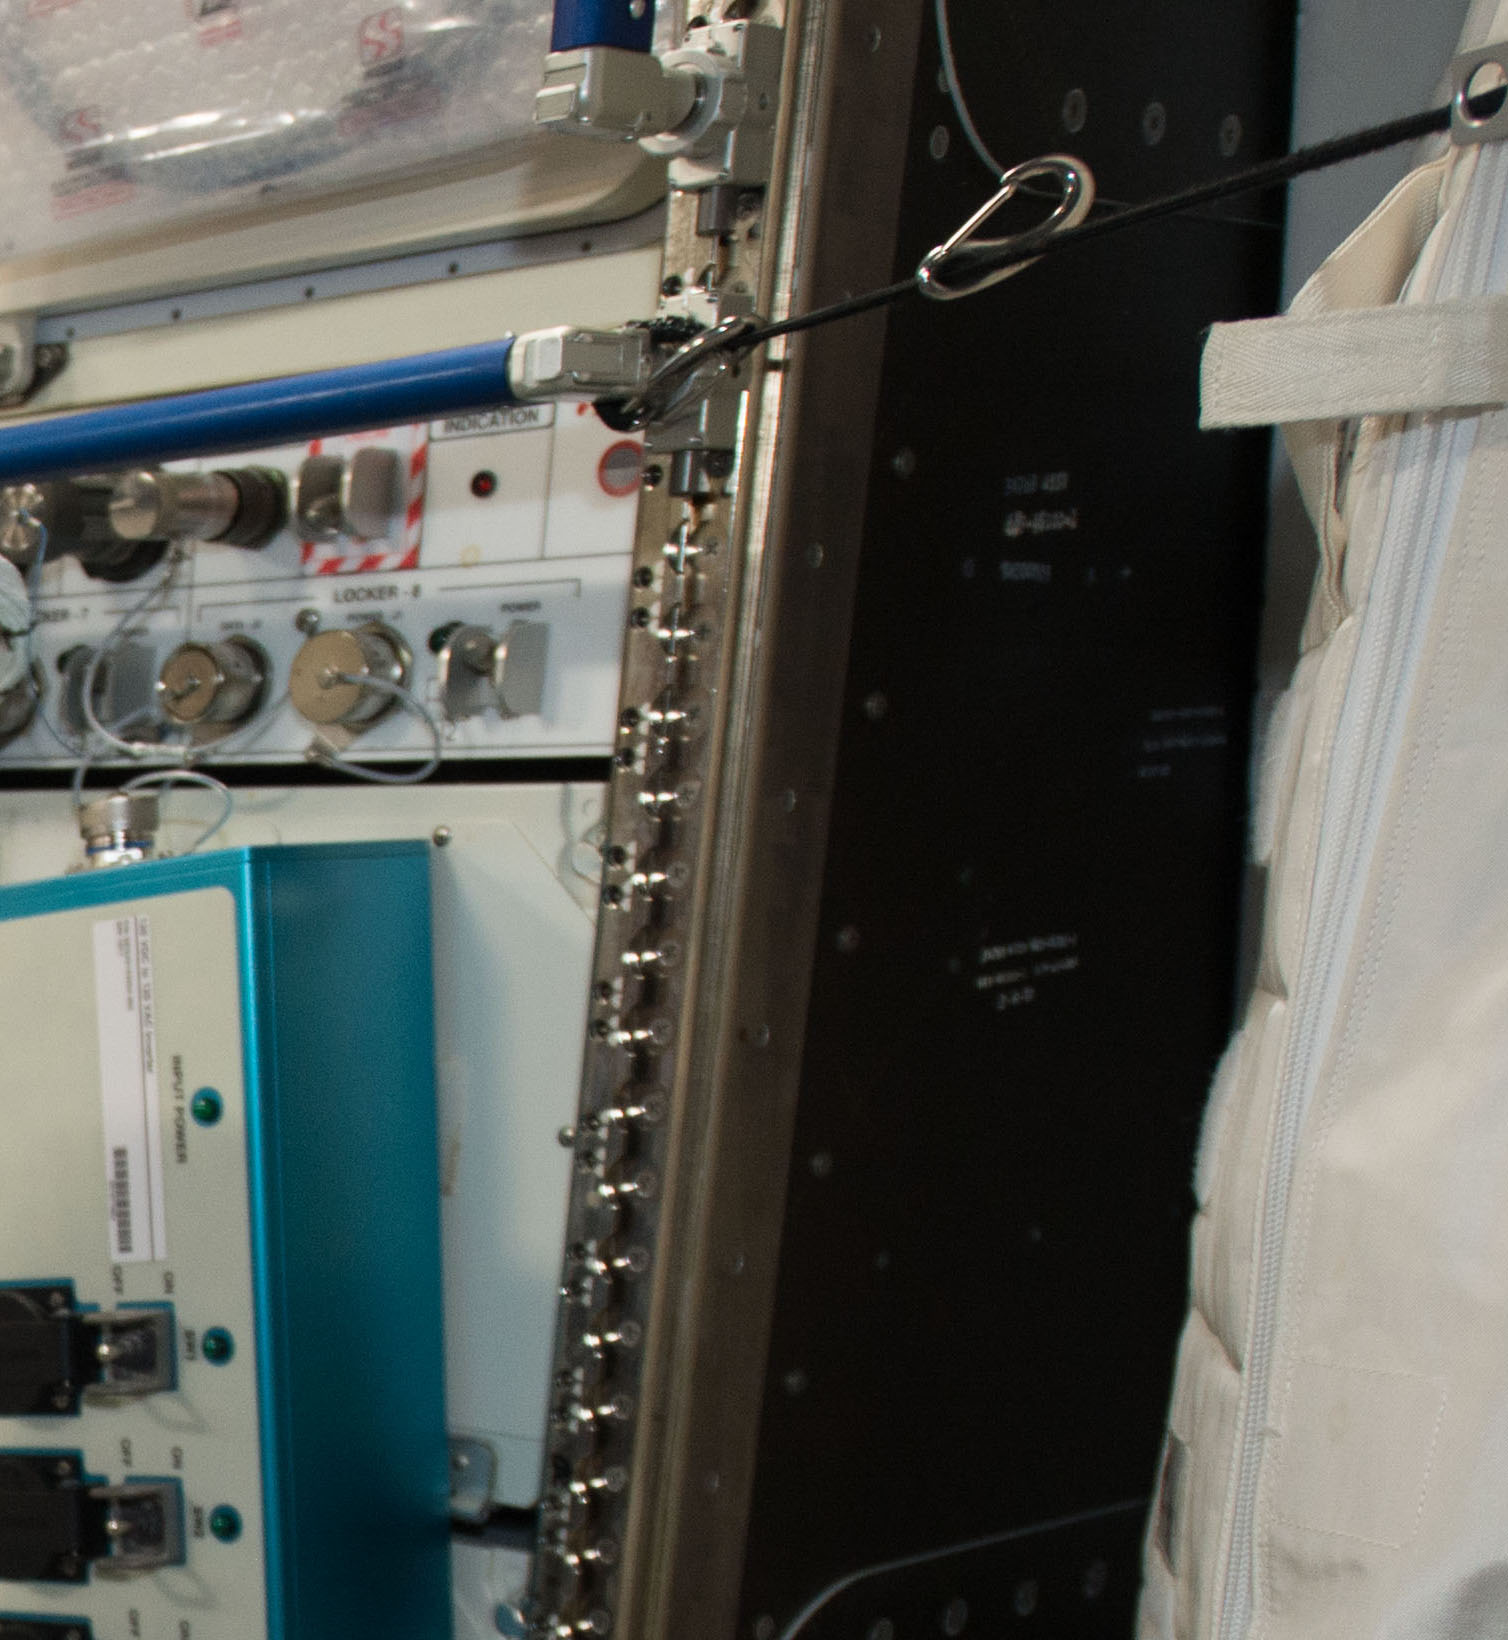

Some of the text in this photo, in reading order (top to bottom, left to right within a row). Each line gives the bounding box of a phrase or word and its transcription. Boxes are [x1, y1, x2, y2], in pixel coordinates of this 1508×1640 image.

[443, 405, 539, 434] INDICATION
[334, 585, 399, 603] LOCKER
[171, 1055, 187, 1164] INPUT POWER
